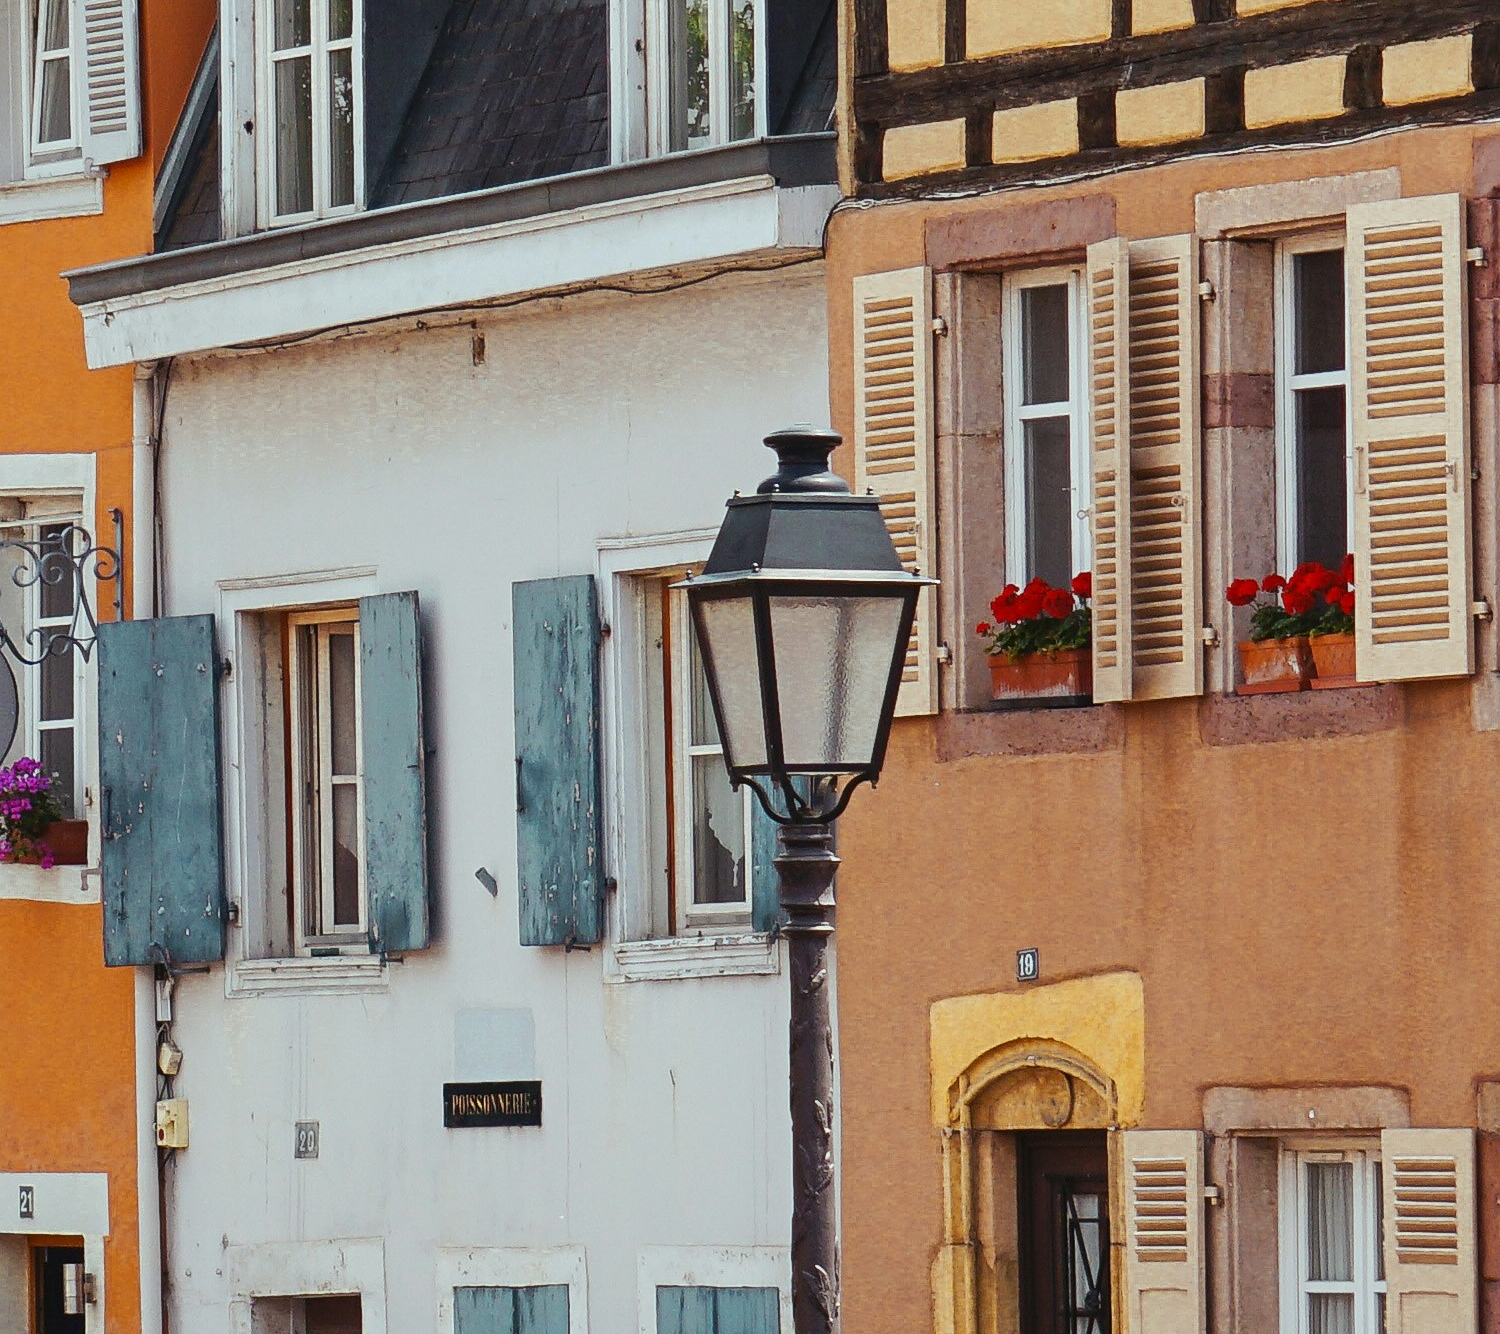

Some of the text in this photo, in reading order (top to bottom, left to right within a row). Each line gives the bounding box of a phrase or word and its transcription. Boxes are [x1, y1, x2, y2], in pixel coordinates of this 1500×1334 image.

[1019, 953, 1034, 976] 19
[452, 1092, 531, 1116] POISSONNERIE
[299, 1130, 315, 1152] 20
[20, 1190, 33, 1213] 21
